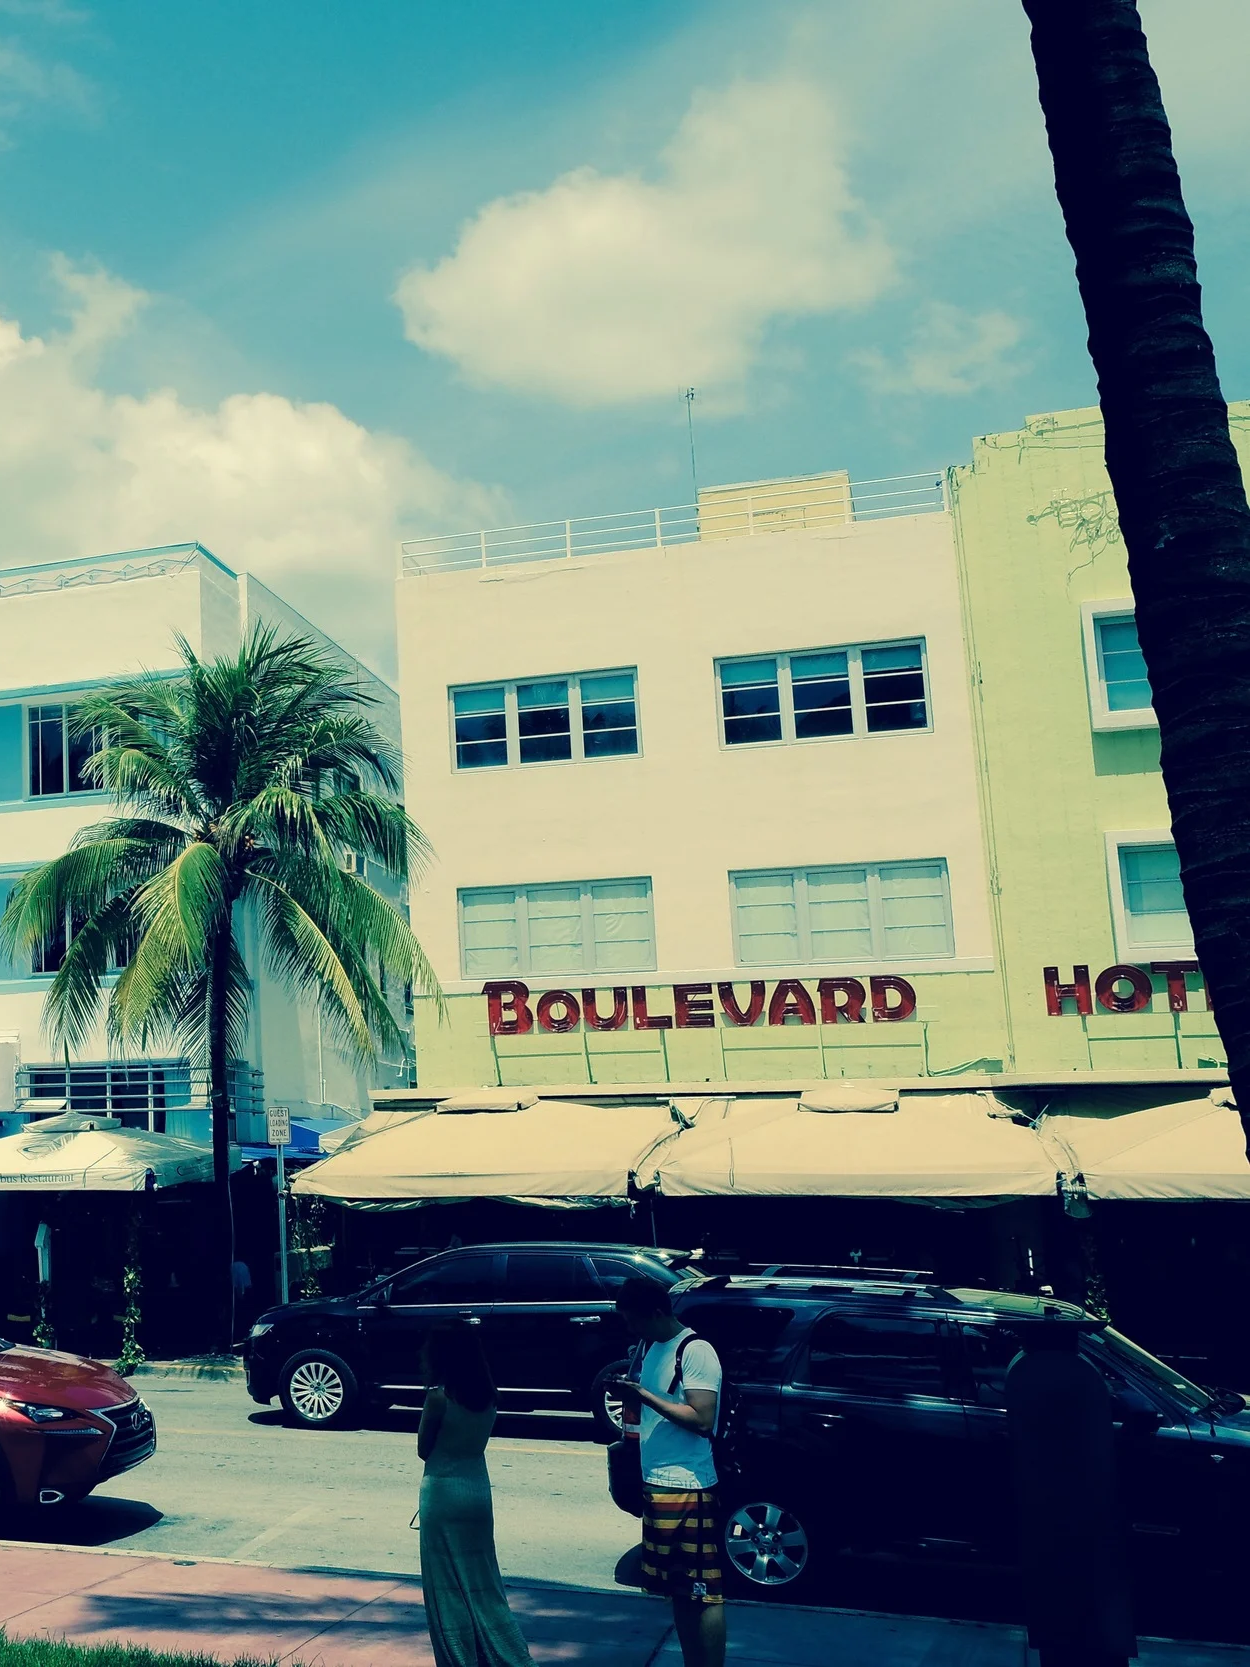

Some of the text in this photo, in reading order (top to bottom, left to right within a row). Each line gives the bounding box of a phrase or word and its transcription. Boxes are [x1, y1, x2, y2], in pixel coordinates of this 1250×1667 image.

[482, 961, 1214, 1036] BOULEVARD HOT
[269, 1109, 287, 1117] GUEST
[20, 1173, 74, 1183] Restaurant
